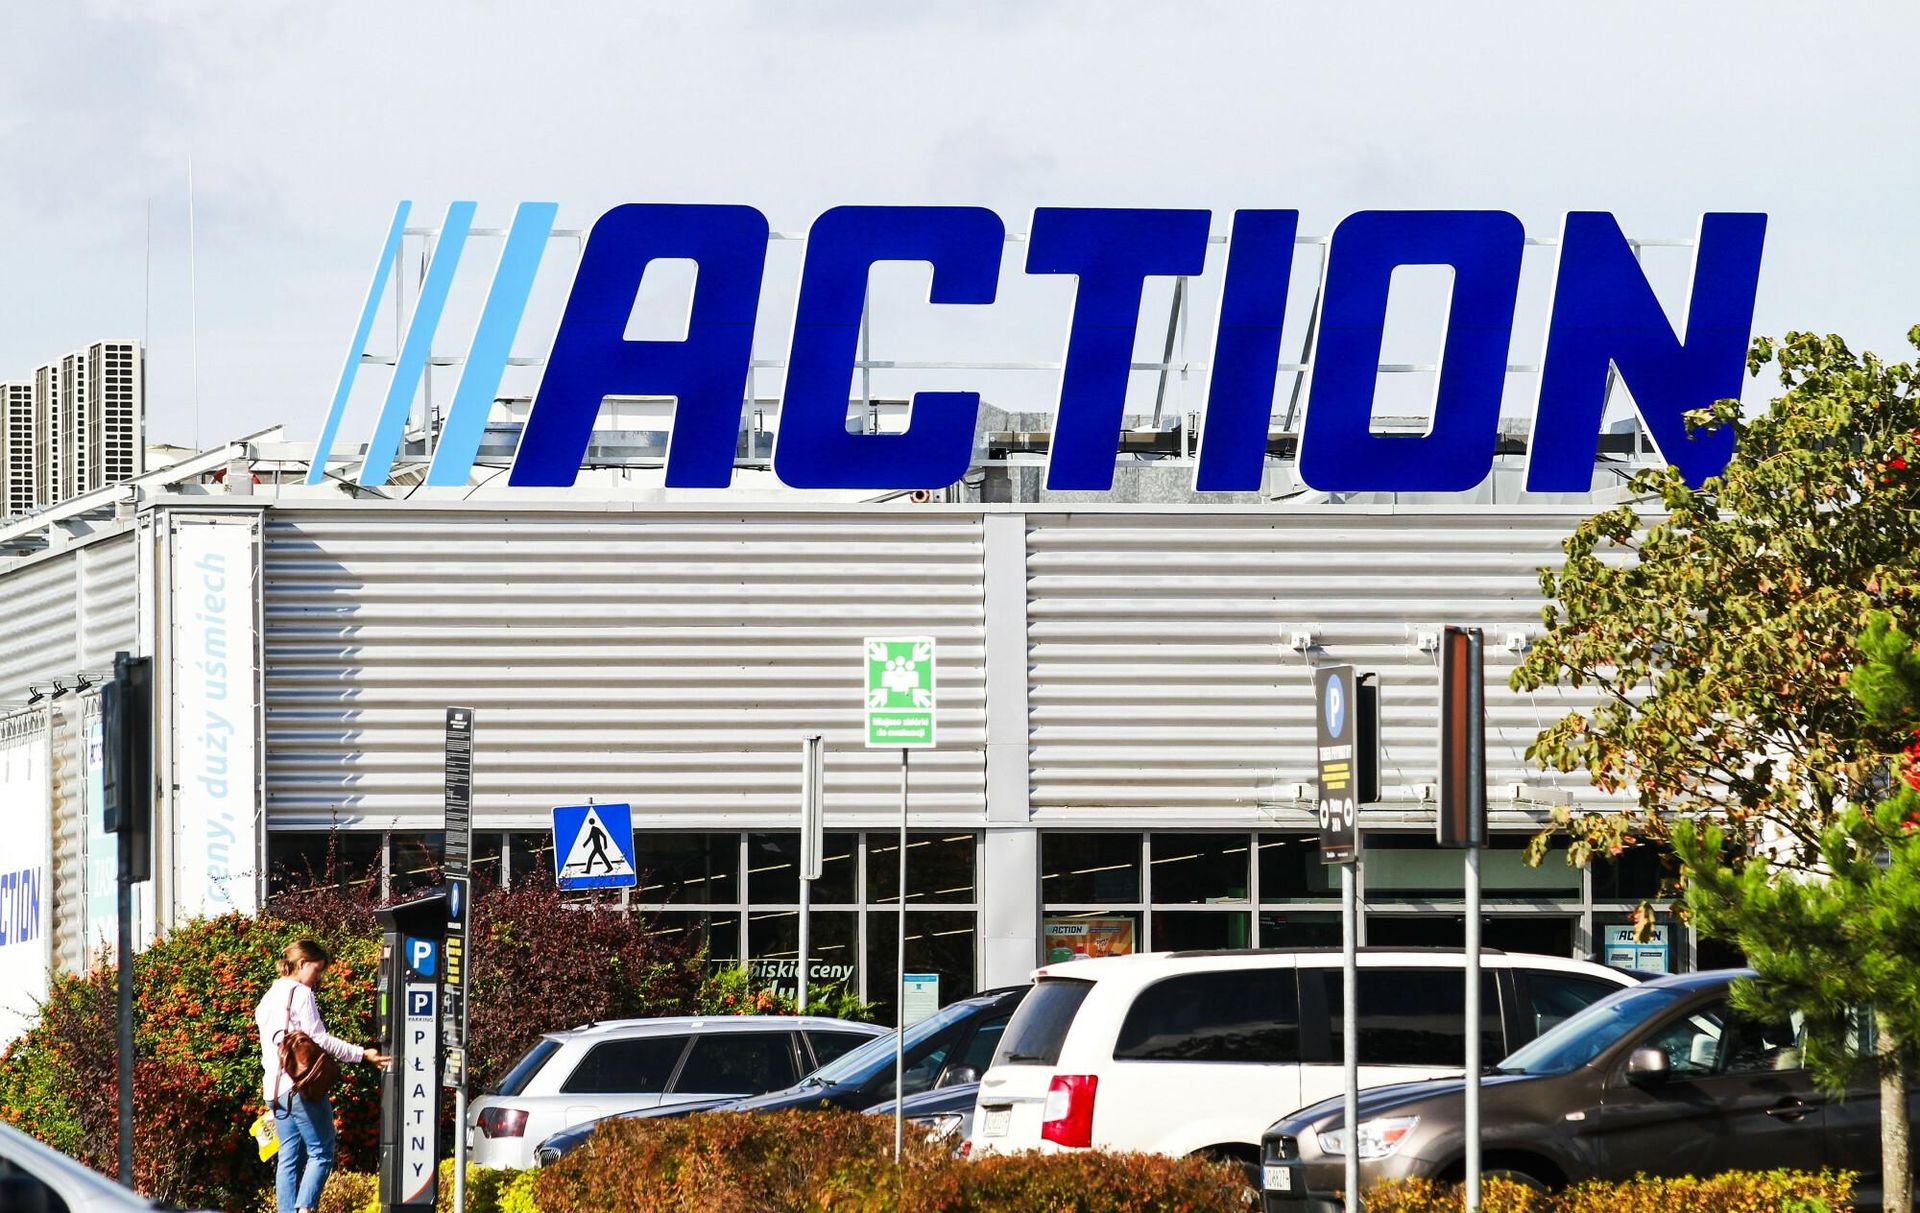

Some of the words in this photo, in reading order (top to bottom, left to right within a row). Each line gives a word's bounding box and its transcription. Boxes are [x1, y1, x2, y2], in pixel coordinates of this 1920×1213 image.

[507, 202, 1768, 493] ACTION
[194, 552, 229, 701] uśmiech
[1329, 687, 1341, 729] P
[197, 710, 235, 799] duży
[1051, 925, 1083, 934] ACTION
[1618, 930, 1662, 941] ACN
[413, 940, 432, 969] P
[810, 964, 854, 982] ceny
[414, 993, 429, 1014] P
